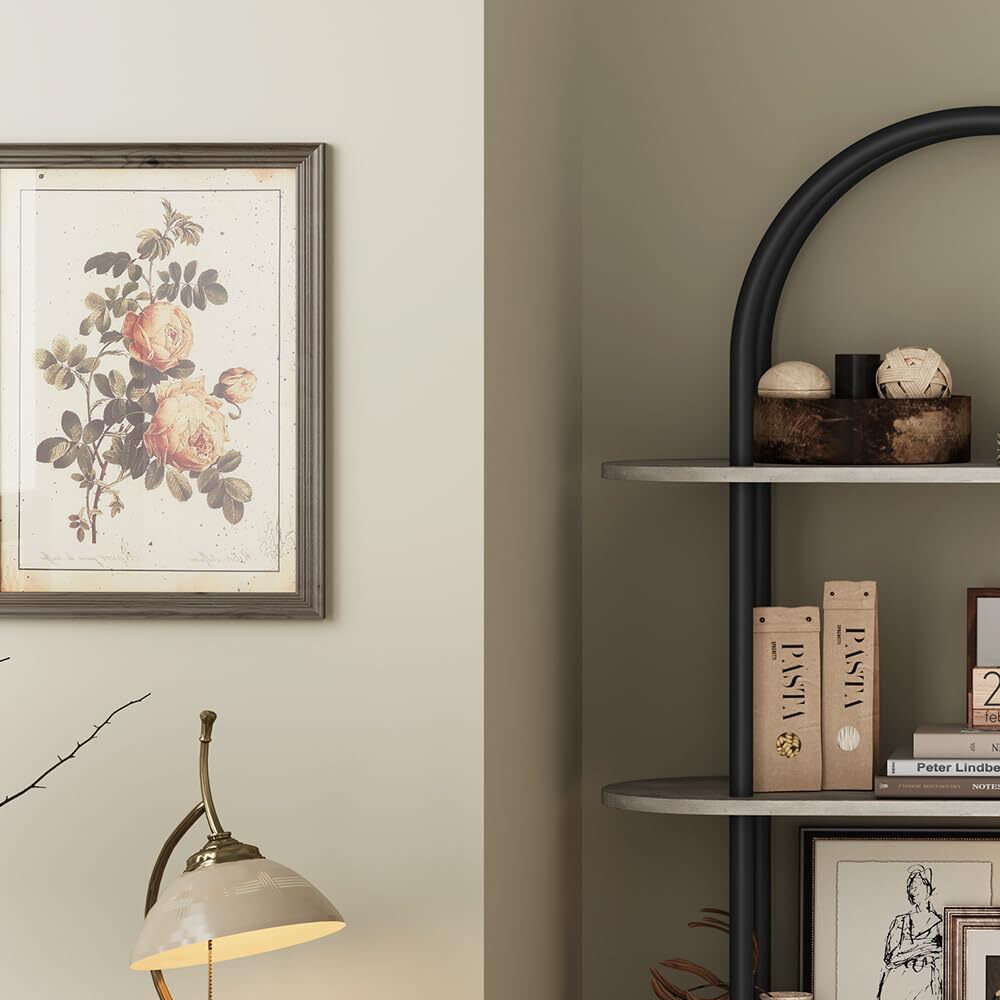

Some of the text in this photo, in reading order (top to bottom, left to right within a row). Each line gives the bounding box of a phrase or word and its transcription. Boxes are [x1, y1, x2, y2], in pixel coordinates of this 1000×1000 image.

[781, 643, 805, 720] PASTA
[844, 628, 866, 709] PASTA
[916, 762, 952, 773] Peter
